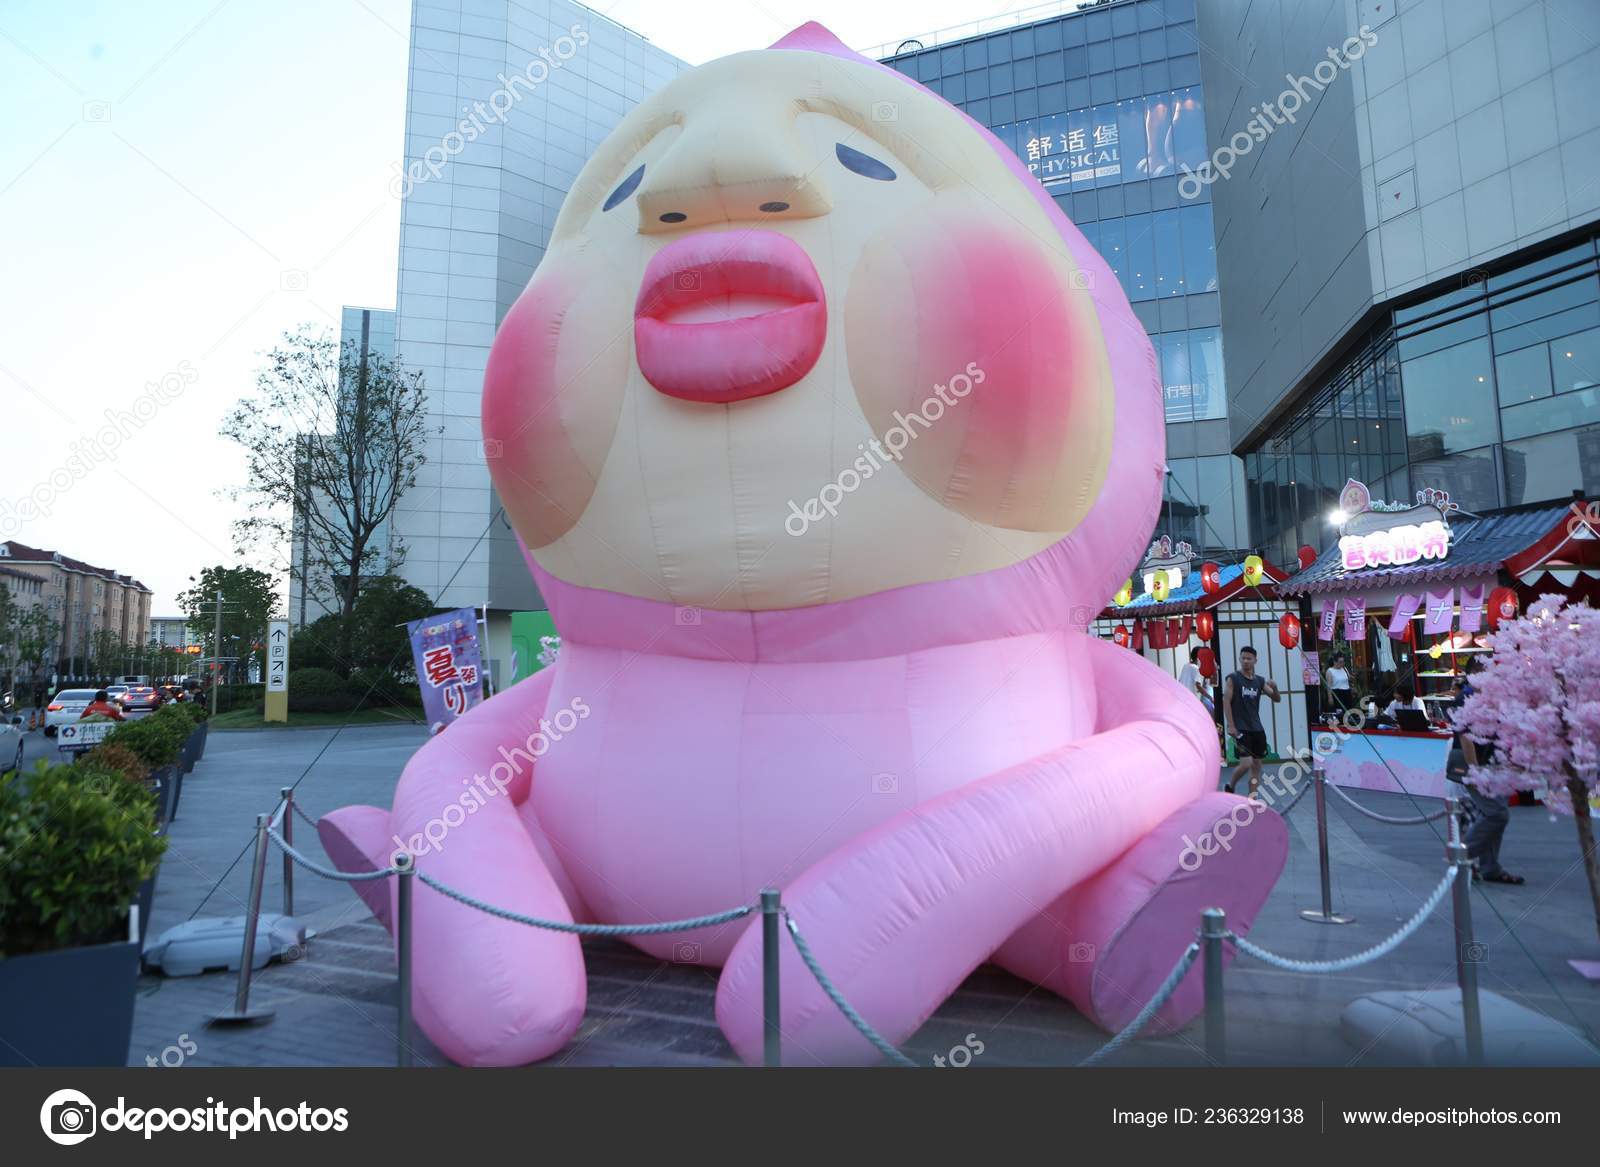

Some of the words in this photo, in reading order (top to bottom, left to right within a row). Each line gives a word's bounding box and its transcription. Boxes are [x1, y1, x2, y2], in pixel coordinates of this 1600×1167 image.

[1026, 125, 1119, 161] 舒适堡
[1027, 148, 1120, 175] PHYSICAL
